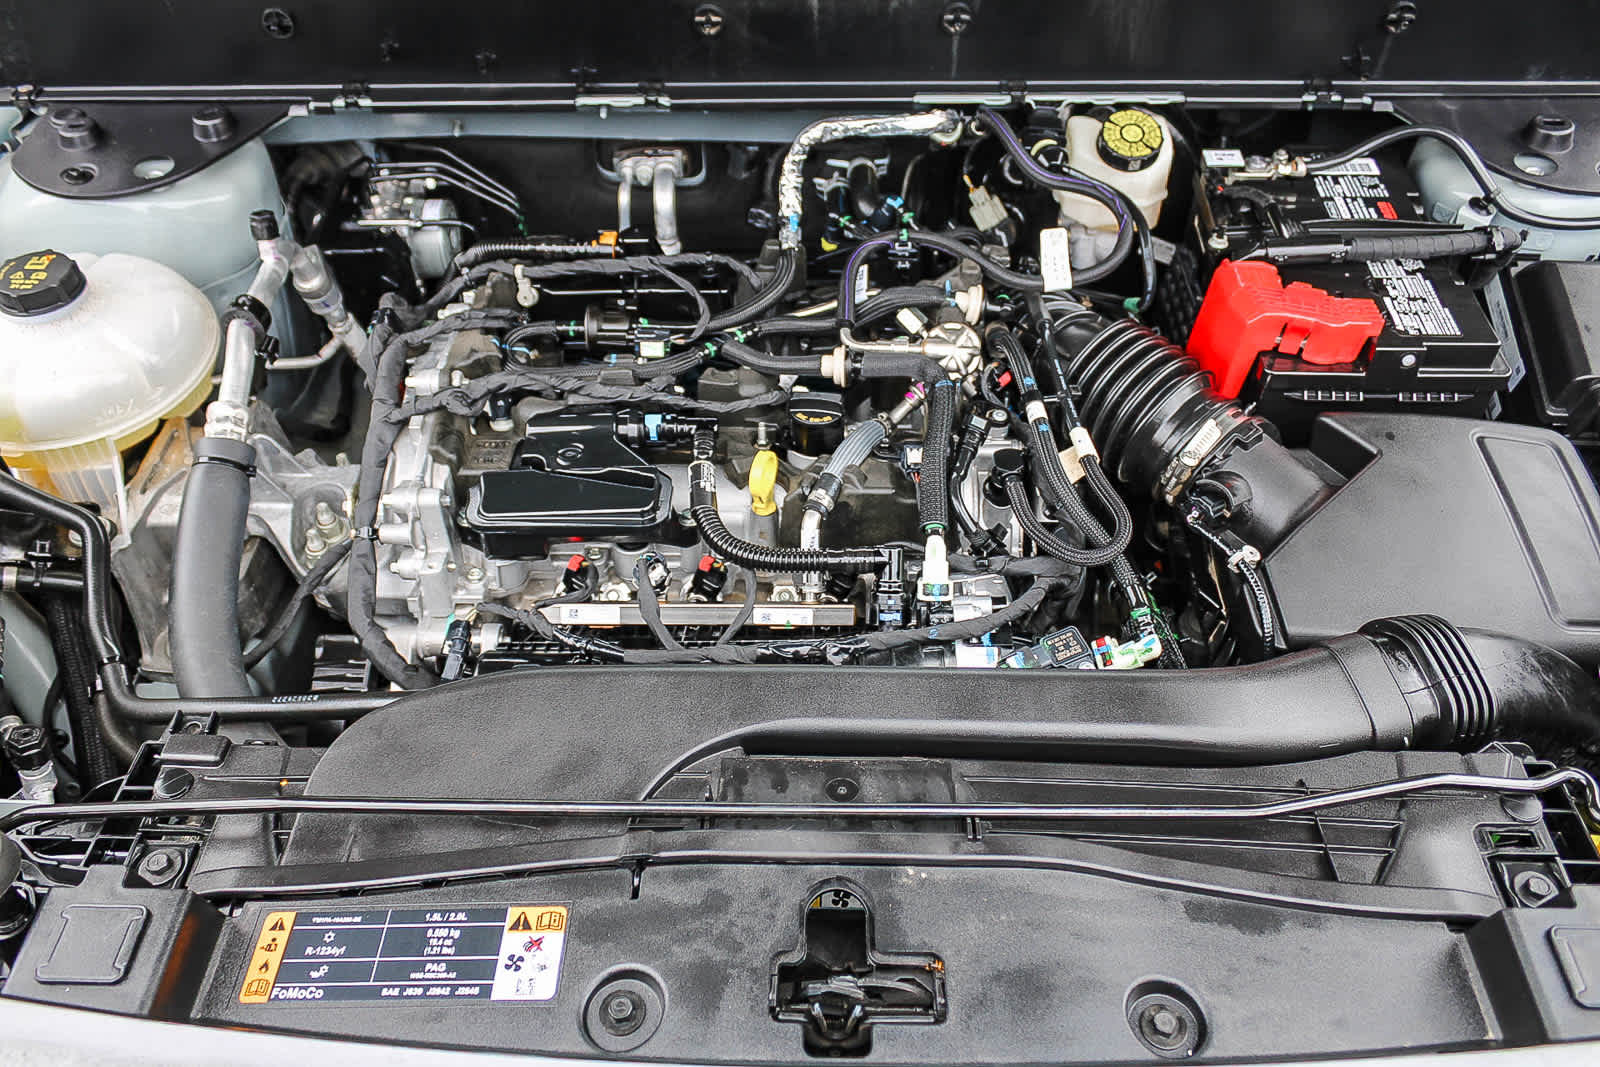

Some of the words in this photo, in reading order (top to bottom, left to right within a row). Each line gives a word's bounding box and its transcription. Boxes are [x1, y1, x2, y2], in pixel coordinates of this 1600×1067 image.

[425, 912, 442, 921] 1.5L
[449, 912, 468, 921] 2.0L
[449, 928, 461, 939] kg
[304, 945, 347, 957] R-1234yf
[425, 962, 447, 972] PAG
[270, 986, 324, 1000] FoMoCo
[381, 987, 401, 996] SAE
